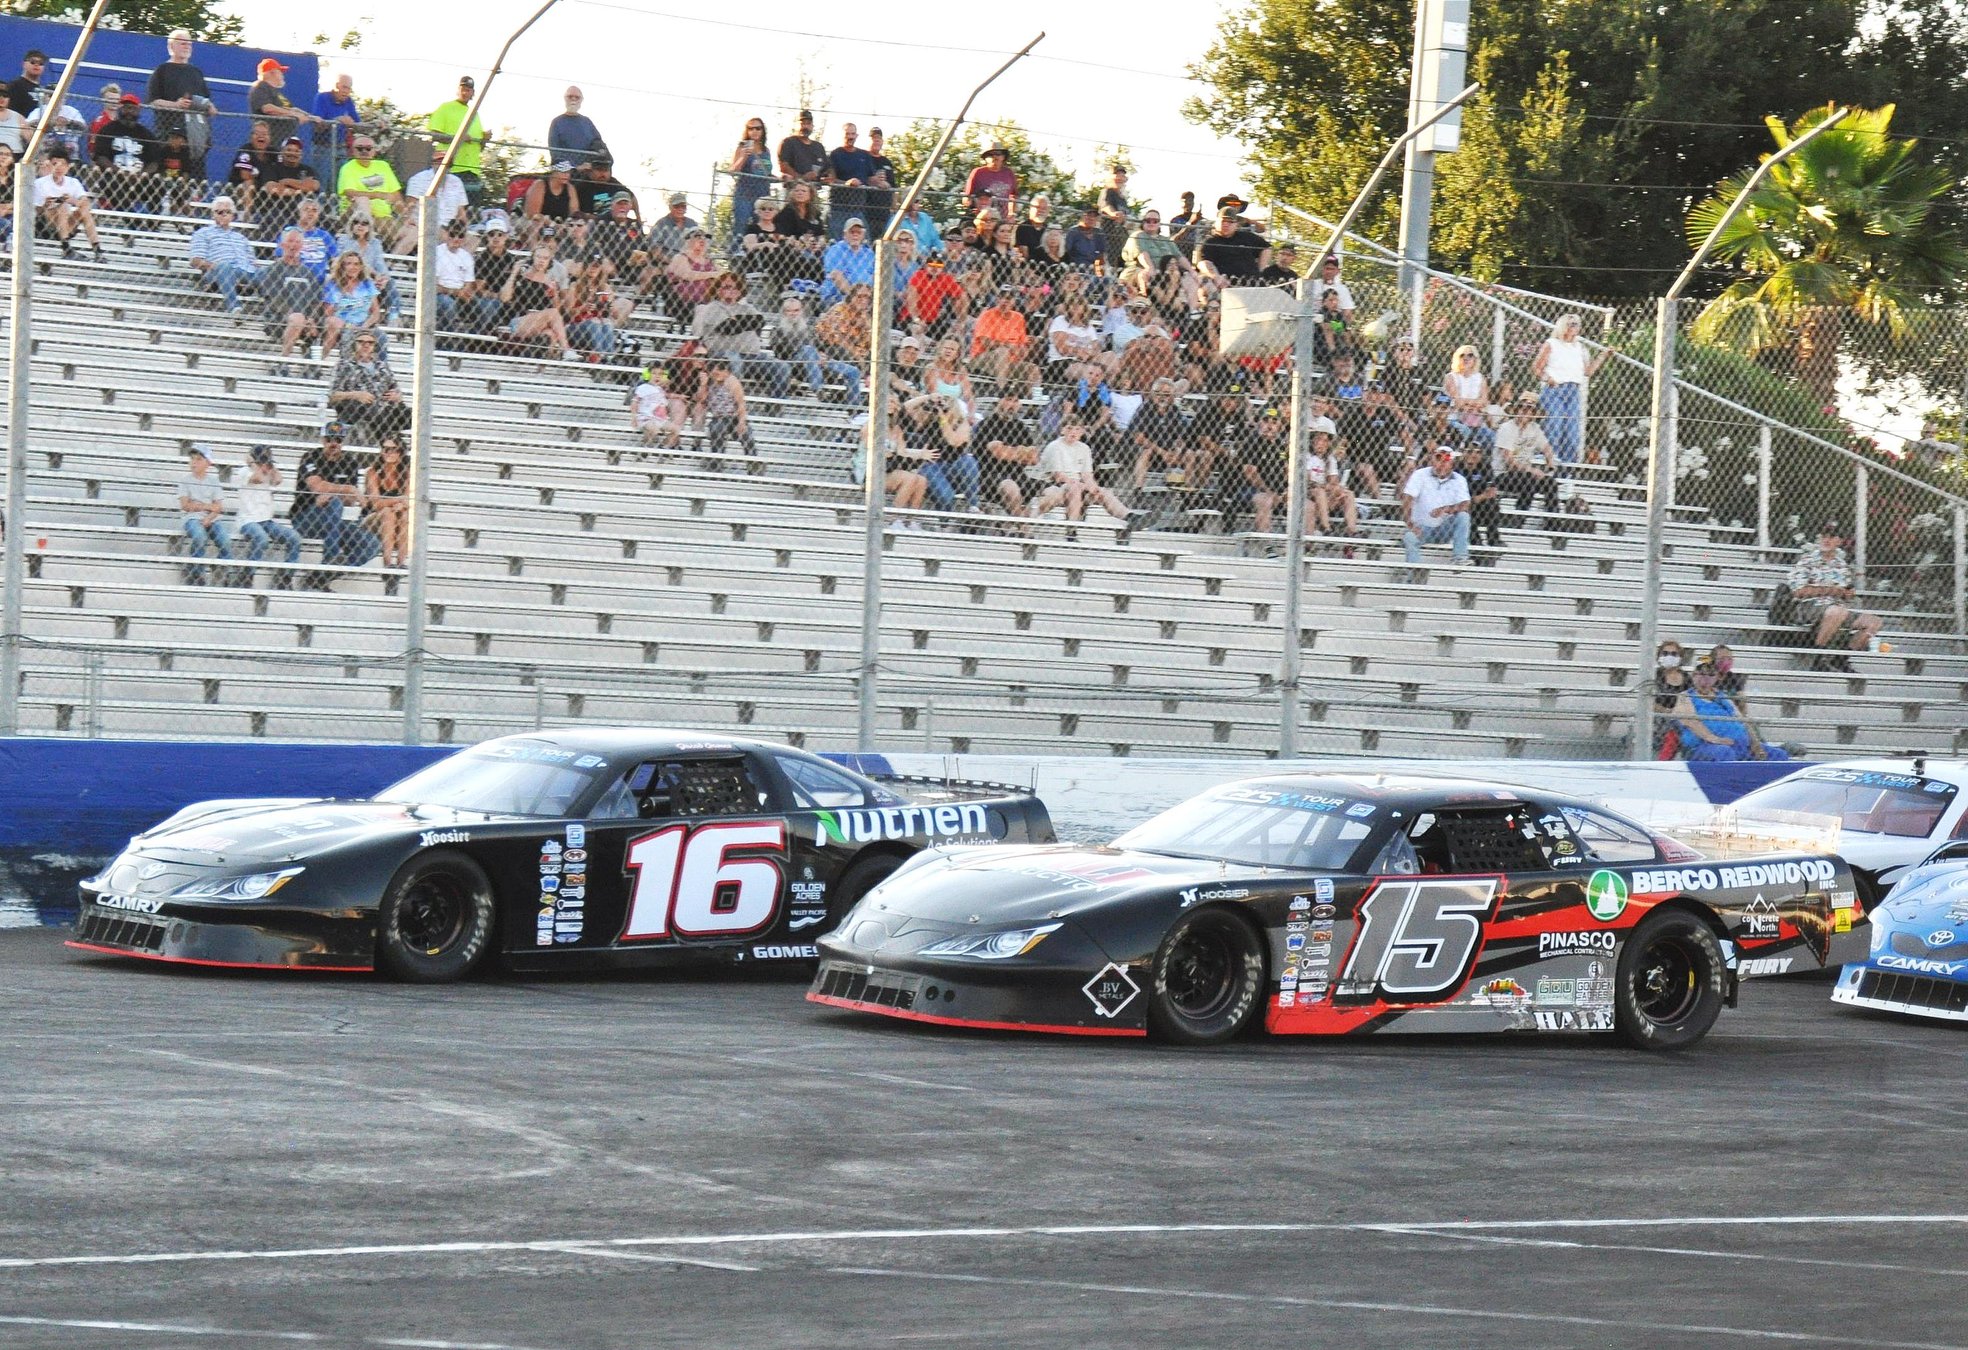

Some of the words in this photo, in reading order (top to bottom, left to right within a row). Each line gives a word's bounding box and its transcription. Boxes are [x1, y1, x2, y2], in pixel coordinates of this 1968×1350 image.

[1301, 794, 1345, 807] TOUR
[815, 804, 988, 848] Nutrien
[1553, 856, 1582, 866] FURY
[620, 821, 785, 940] 16
[1632, 868, 1719, 893] BERCO
[1719, 860, 1836, 889] REDWOOD
[791, 883, 826, 892] GOLDEN
[795, 892, 821, 900] ACRES
[1199, 889, 1249, 900] HOOSIER
[96, 892, 164, 914] CAMRY
[1336, 880, 1497, 994] 15
[1539, 931, 1616, 951] PINASCO
[1540, 949, 1573, 958] MECHANICAL
[1736, 957, 1794, 974] FURY
[1877, 956, 1966, 975] CAMRY
[1103, 982, 1120, 993] BV
[1533, 1011, 1615, 1030] HALE
